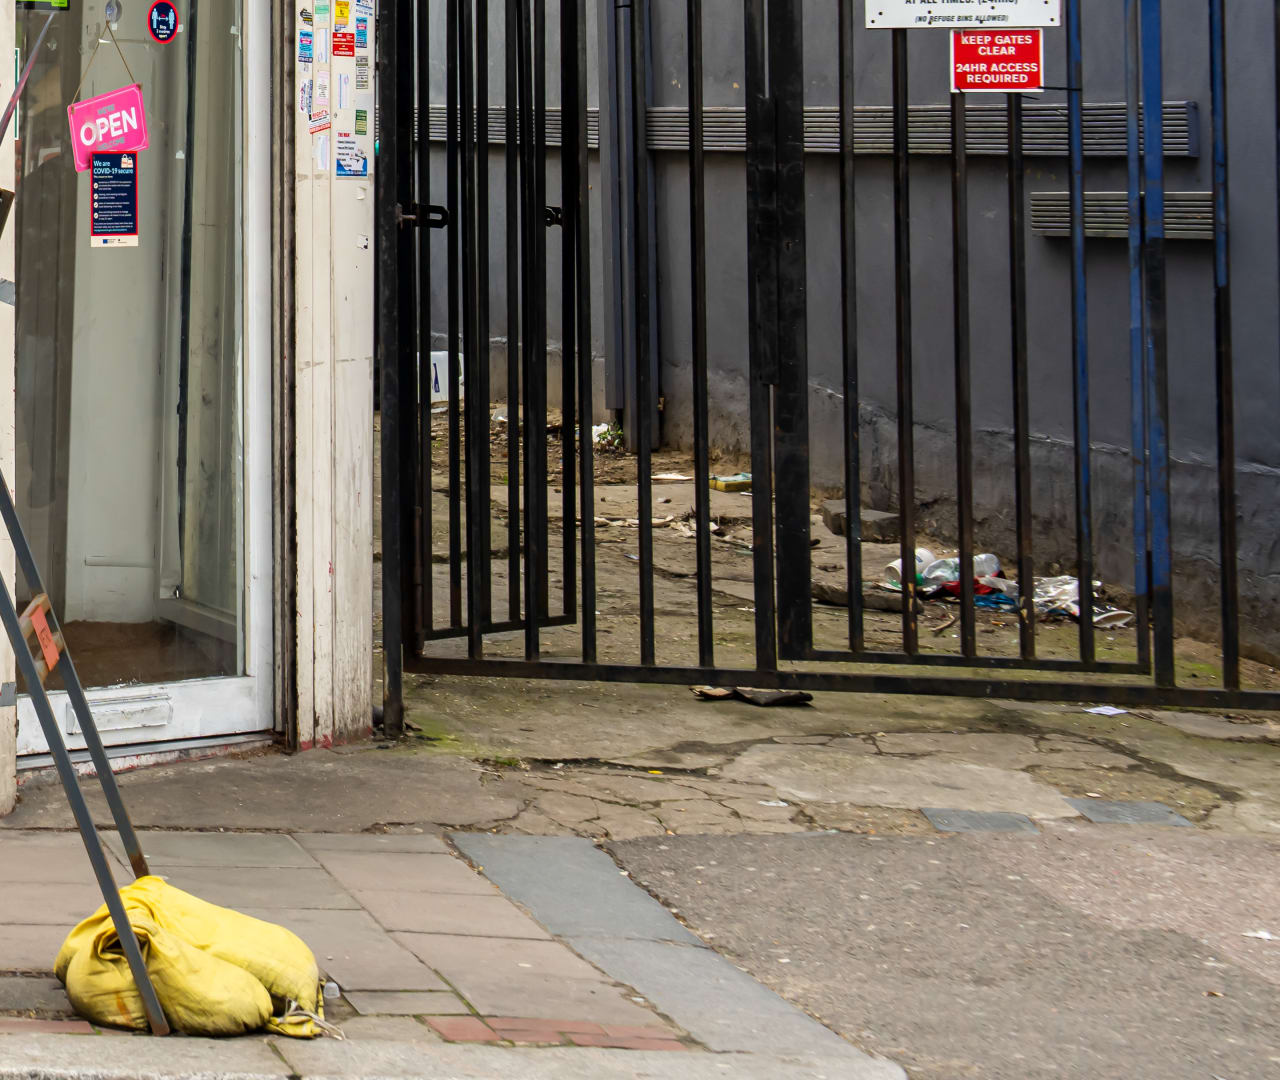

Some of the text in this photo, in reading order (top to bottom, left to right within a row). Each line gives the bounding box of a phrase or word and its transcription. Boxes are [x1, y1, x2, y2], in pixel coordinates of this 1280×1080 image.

[915, 15, 927, 23] (NO
[931, 15, 954, 23] REFUGE
[975, 14, 1008, 22] ALLOWED)
[961, 35, 1032, 45] KEEP GATES
[978, 46, 1015, 56] CLEAR
[956, 63, 1038, 72] 24HR ACCESS
[967, 74, 1028, 83] REQUIRED
[80, 107, 138, 146] OPEN
